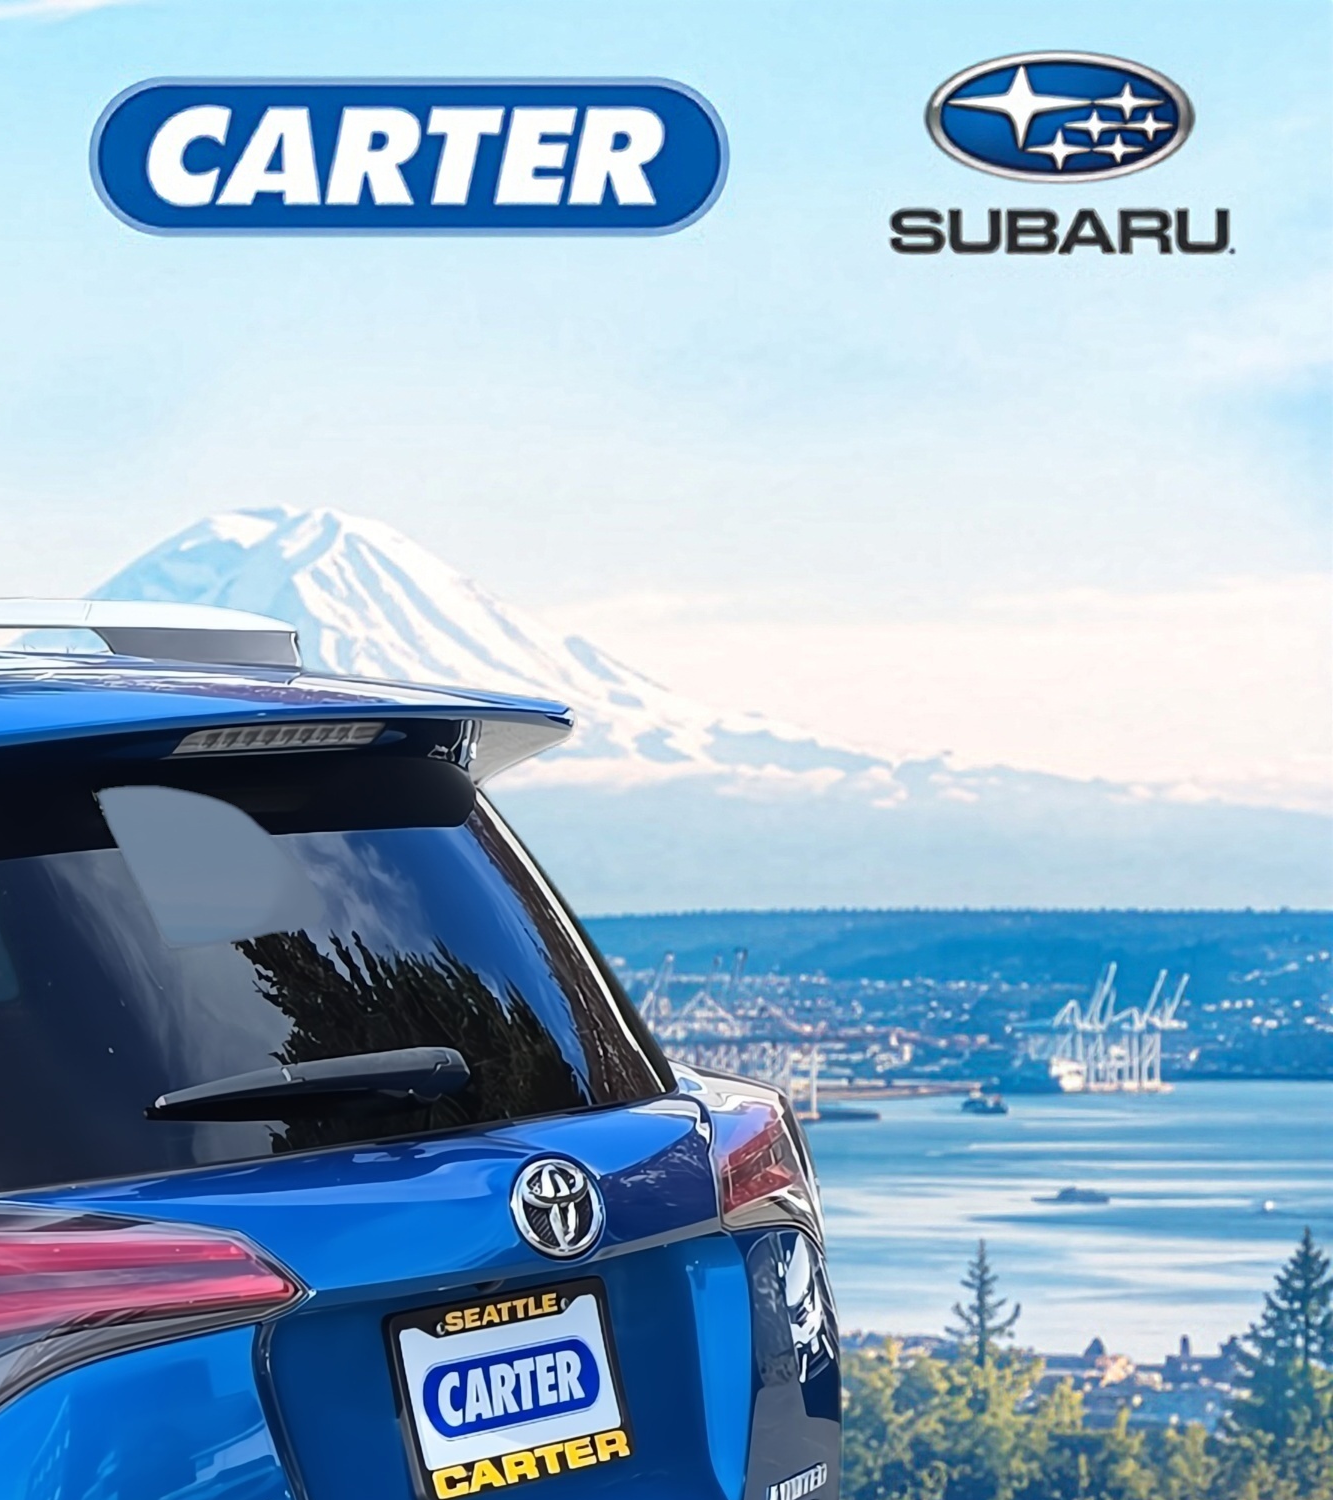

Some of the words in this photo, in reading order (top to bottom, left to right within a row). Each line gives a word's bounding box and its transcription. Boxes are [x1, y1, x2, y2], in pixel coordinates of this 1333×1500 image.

[444, 1292, 559, 1333] SEATTLE
[437, 1349, 586, 1427] CARTER
[432, 1429, 631, 1500] CARTER
